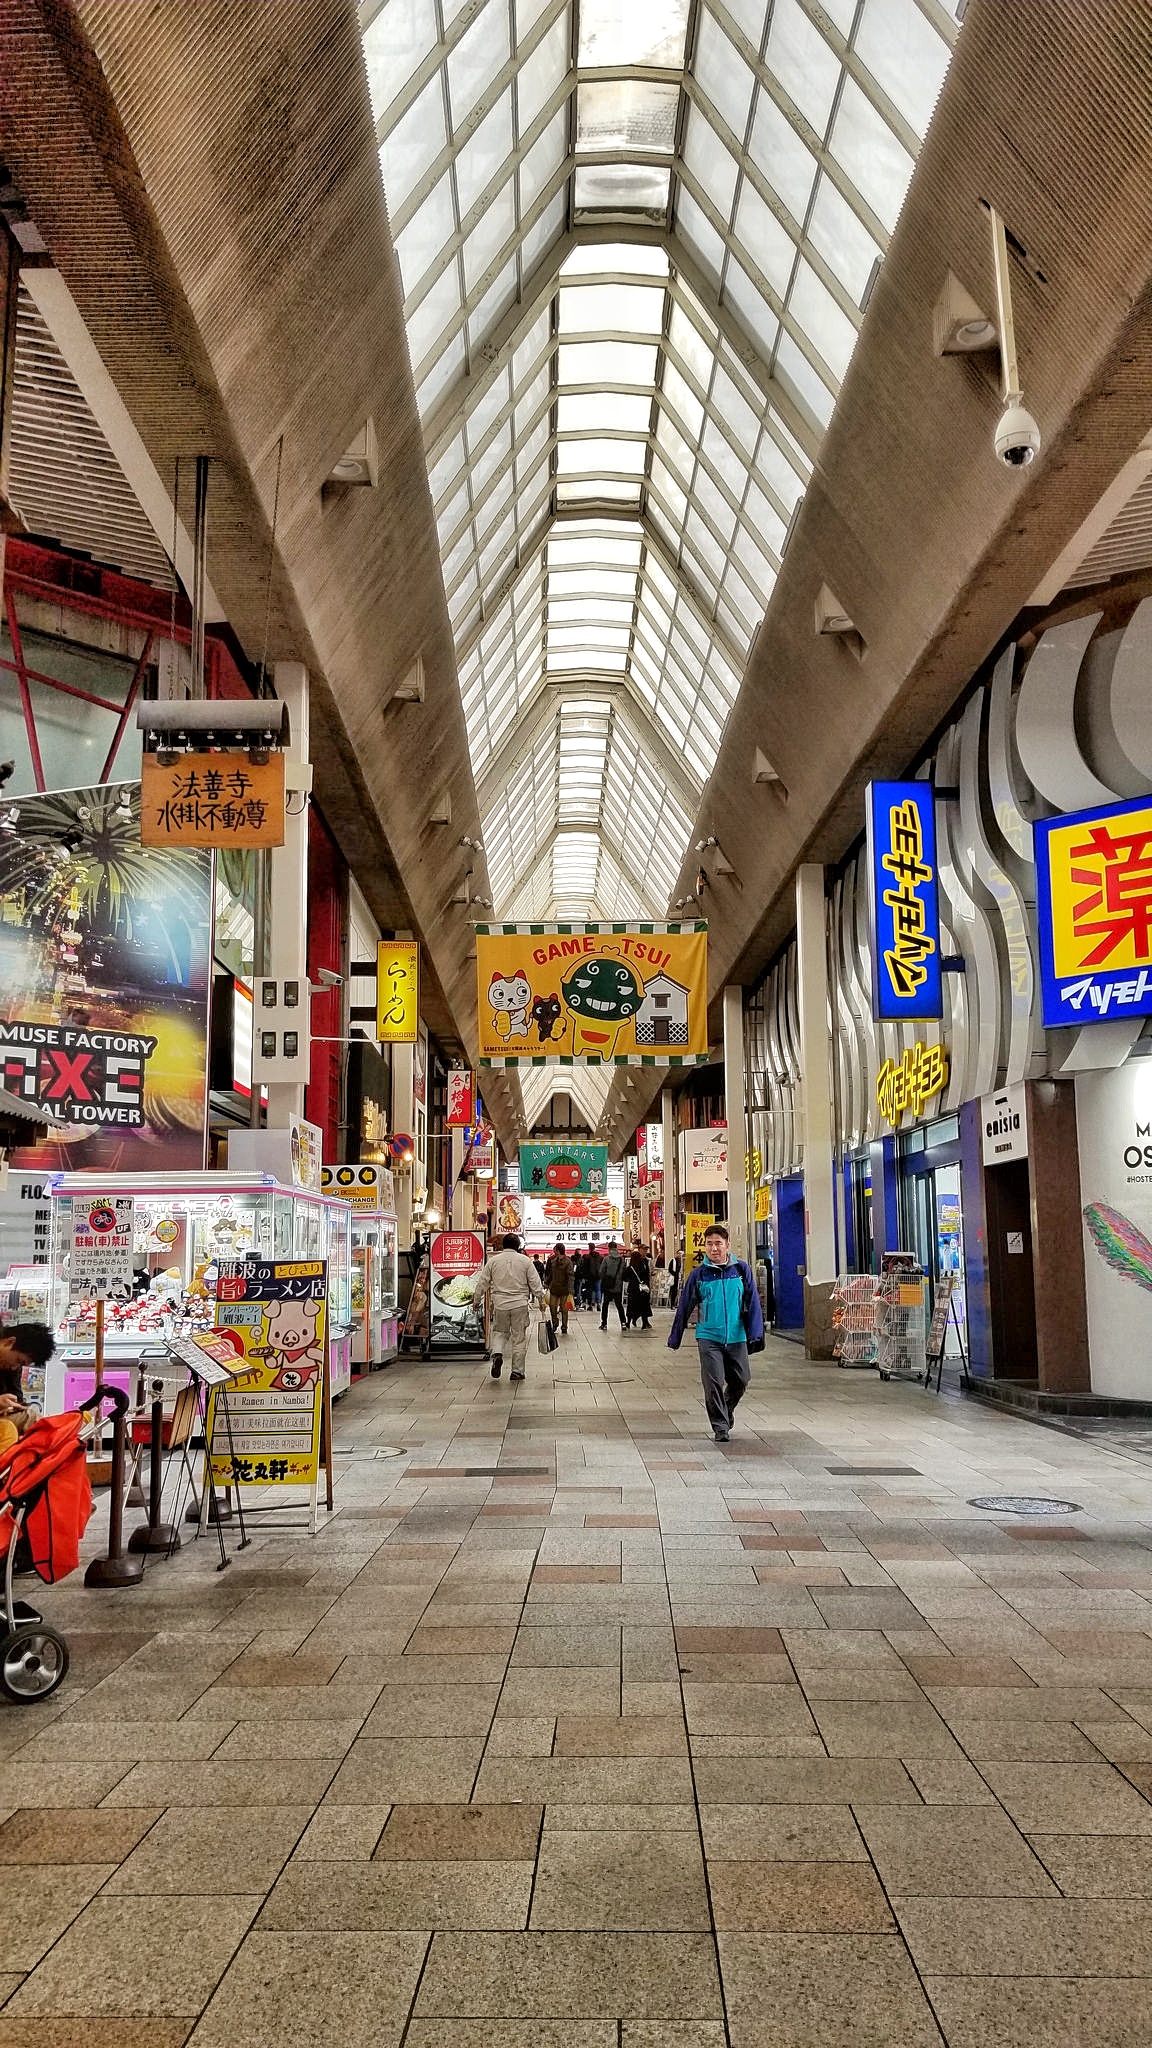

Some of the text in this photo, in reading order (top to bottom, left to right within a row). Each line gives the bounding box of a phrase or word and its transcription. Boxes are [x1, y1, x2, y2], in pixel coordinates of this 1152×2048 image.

[172, 770, 253, 800] 法善寺
[156, 799, 269, 832] 水掛不動尊
[532, 936, 672, 969] GAME TSUI
[65, 1031, 153, 1055] FACTORY
[29, 1101, 141, 1124] AL TOWER
[986, 1107, 1021, 1138] enisia
[532, 1146, 596, 1161] AKANTARE
[75, 1236, 130, 1248] 駐輪(車)禁止
[79, 1276, 124, 1289] 法善寺
[219, 1262, 320, 1280] 難波の とびきり
[221, 1279, 326, 1300] 旨い ラーメン店
[241, 1396, 265, 1406] Ramen
[270, 1396, 278, 1405] in
[282, 1394, 310, 1405] Namba!
[231, 1458, 289, 1482] 花丸軒
